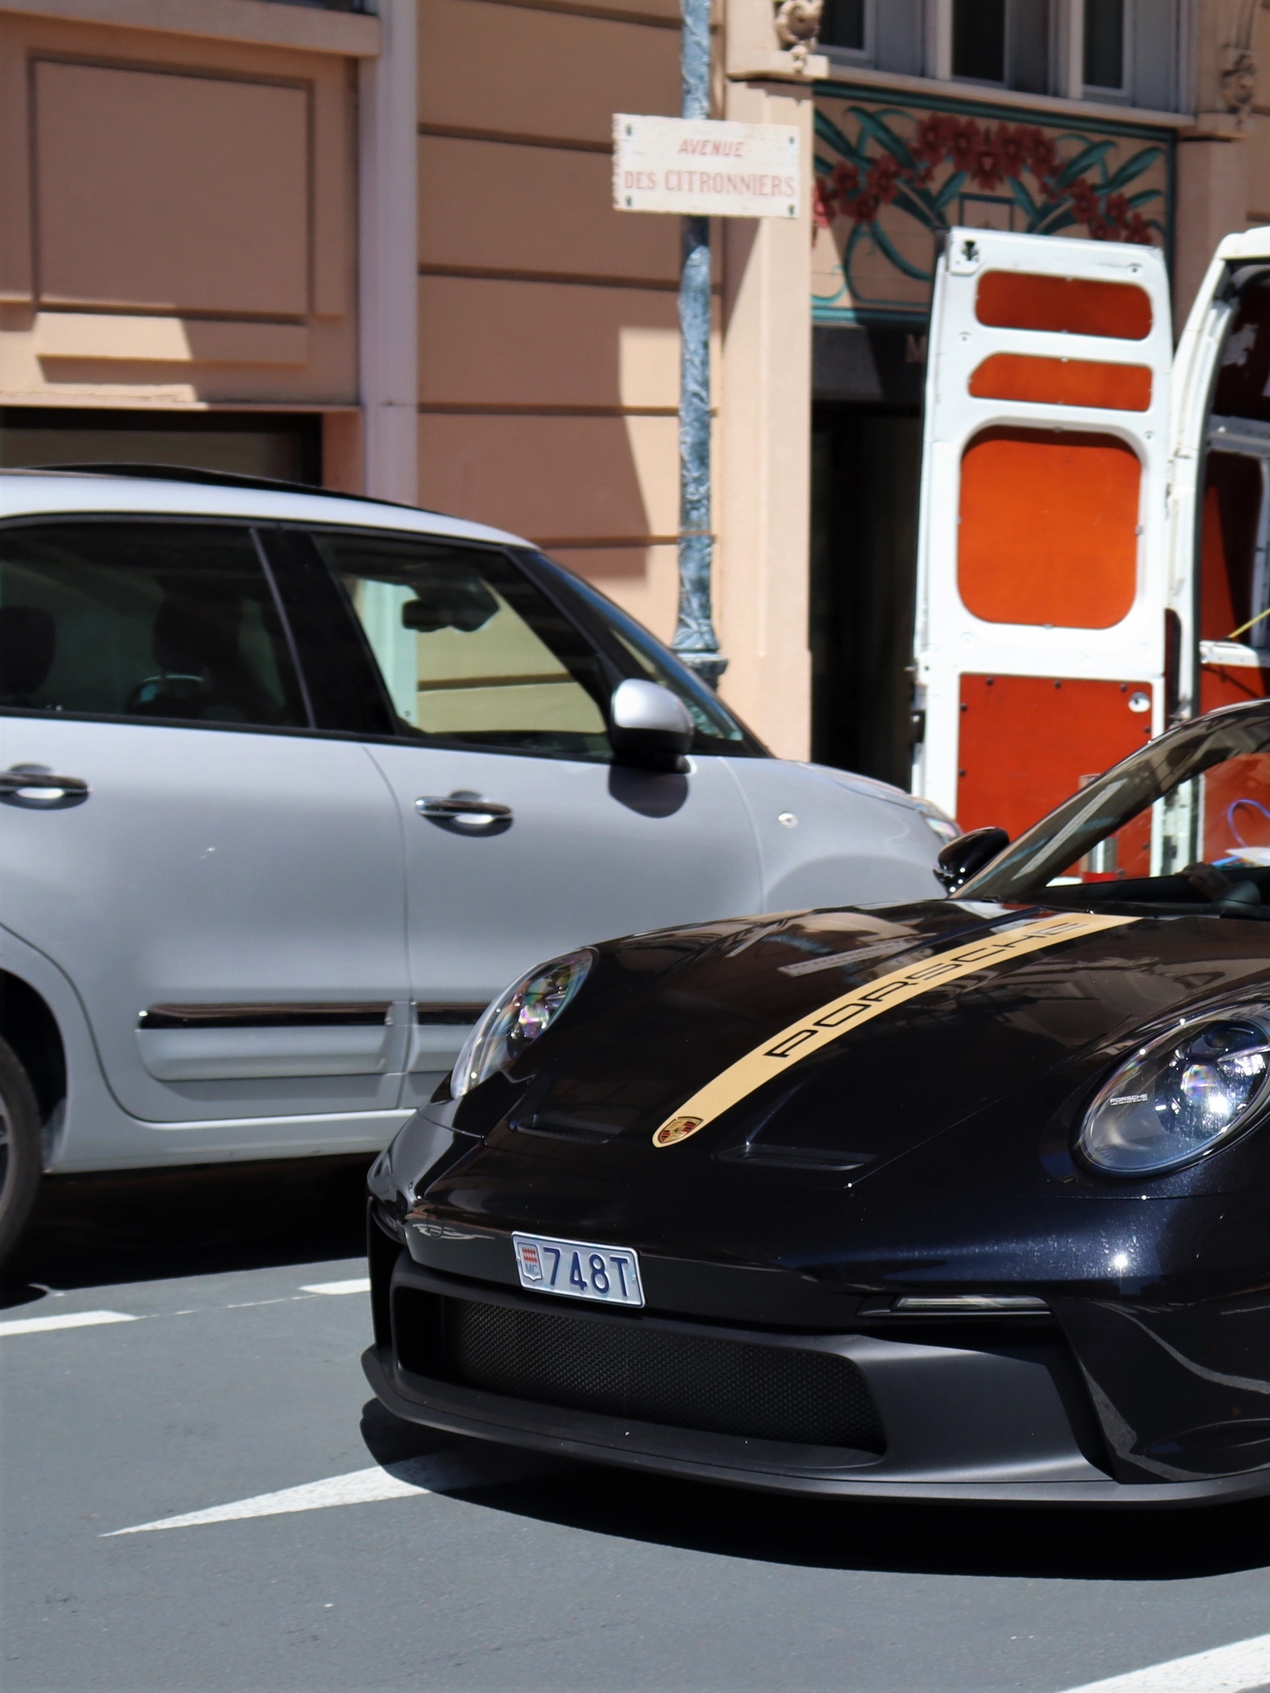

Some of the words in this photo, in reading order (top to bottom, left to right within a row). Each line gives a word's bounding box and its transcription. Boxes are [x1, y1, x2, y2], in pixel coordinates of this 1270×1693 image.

[678, 138, 746, 158] AVENUE
[623, 171, 657, 191] DES
[664, 169, 796, 198] CITRONNIERS
[762, 921, 1091, 1058] PORSCHE
[524, 1263, 540, 1276] MC
[542, 1246, 629, 1297] 748T
